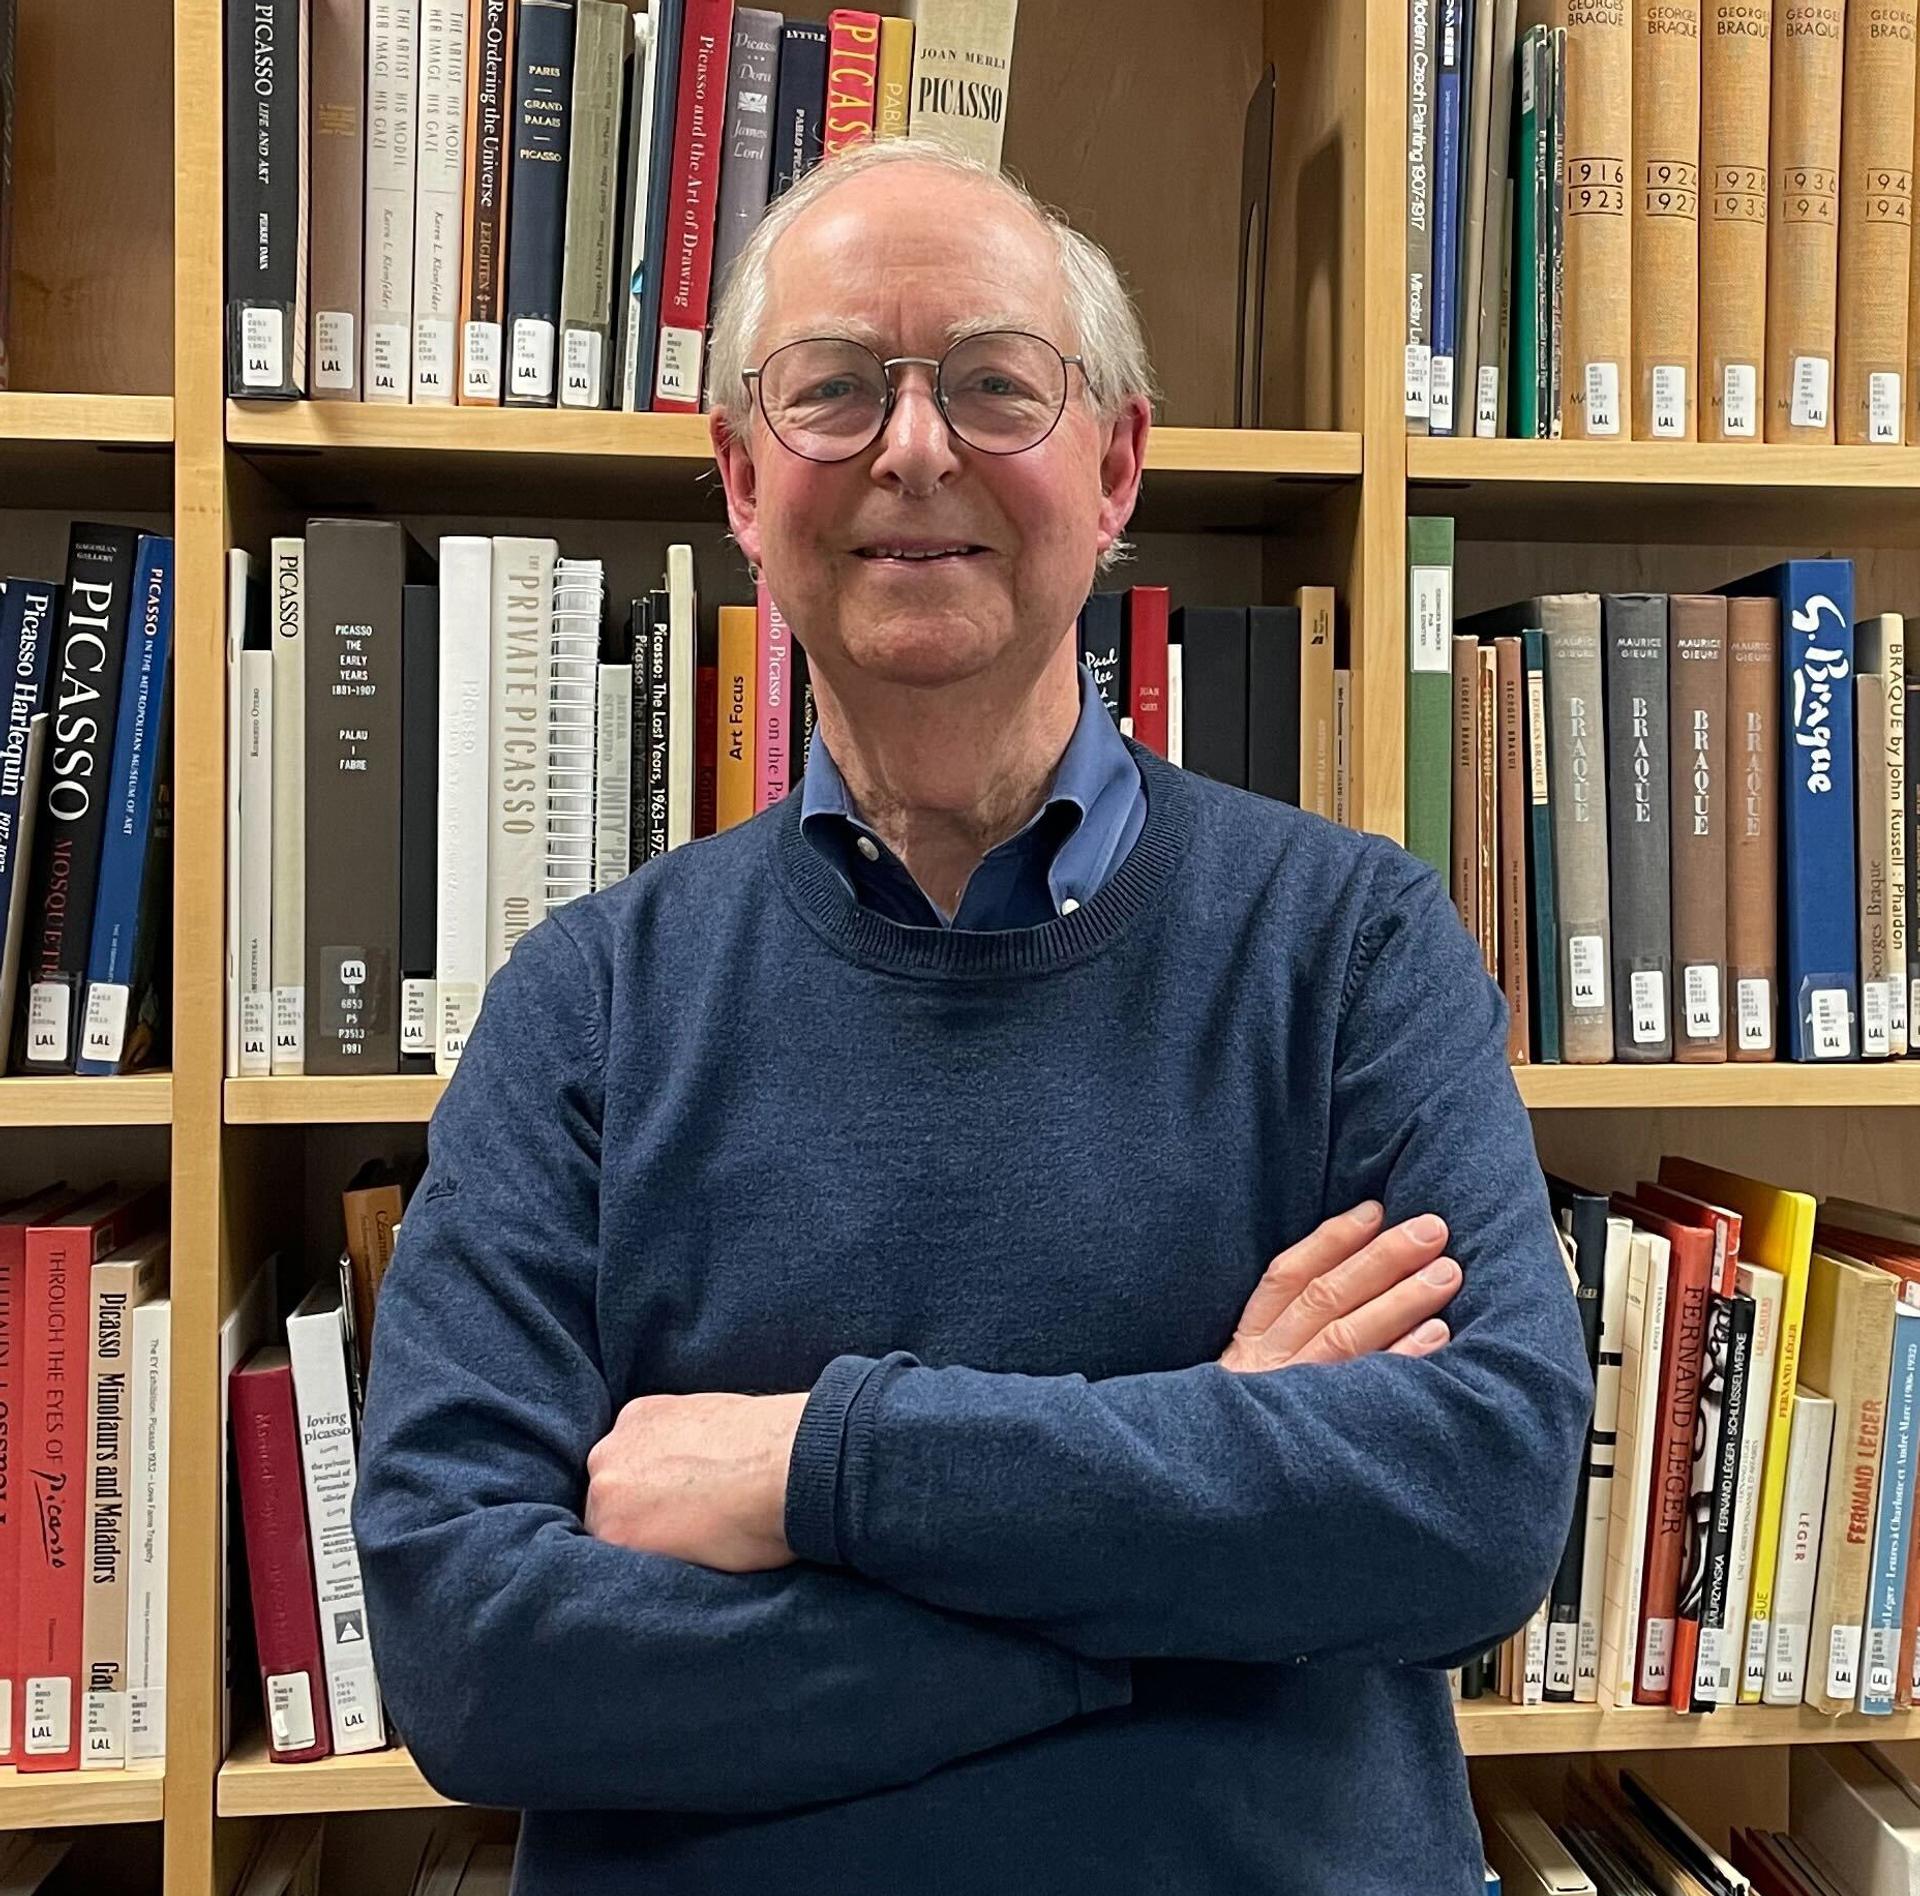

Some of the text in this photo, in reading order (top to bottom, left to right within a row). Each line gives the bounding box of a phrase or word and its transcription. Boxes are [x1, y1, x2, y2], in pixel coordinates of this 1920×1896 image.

[396, 9, 411, 30] THE
[449, 12, 464, 34] THE
[1413, 0, 1429, 51] odern
[1568, 12, 1624, 26] BRAQUE
[480, 0, 504, 104] Re-Ordering
[920, 48, 1006, 70] JOAN MERLI
[528, 65, 561, 78] PARIS
[738, 64, 772, 83] Dora
[1412, 53, 1428, 104] Czech
[254, 3, 274, 185] PICASSO LIFE AND ART
[918, 76, 1003, 124] PICASSO
[524, 100, 563, 112] GRAND
[484, 108, 500, 134] the
[524, 114, 561, 127] PALAIS
[732, 120, 768, 140] James
[794, 108, 805, 146] PABLO
[1409, 104, 1428, 163] Painting
[520, 150, 562, 162] PICASSO
[733, 142, 764, 162] Lord
[480, 137, 499, 208] Universe
[674, 34, 715, 308] Picasso and the Art of Drawing
[1568, 164, 1624, 184] 1916
[1568, 190, 1624, 210] 1923
[1646, 193, 1696, 214] 1927
[250, 359, 269, 371] LAL
[322, 360, 341, 372] LAL
[420, 373, 439, 385] LAL
[469, 372, 488, 384] LAL
[569, 376, 588, 389] LAL
[662, 374, 680, 388] LAL
[1432, 394, 1449, 406] LAL
[1480, 410, 1496, 422] LAL
[1658, 416, 1674, 428] LAL
[1728, 416, 1744, 428] LAL
[1877, 426, 1893, 436] LAL
[279, 554, 299, 638] PICASSO
[335, 624, 373, 636] PICASSO
[346, 640, 362, 651] THE
[1616, 638, 1662, 649] MAURICE
[1677, 638, 1722, 650] MAURICE
[340, 654, 368, 666] EARLY
[1086, 648, 1118, 671] Paul
[1682, 650, 1719, 660] GIEURE
[340, 670, 368, 681] YEARS
[1, 592, 50, 797] Picasso Harlequin
[49, 577, 114, 821] PICASSO
[123, 568, 164, 836] PICASSO IN THE METROPOLITAN MUSEUM OF ART
[502, 574, 540, 834] PRIVATE PICASSO
[650, 622, 668, 784] Picasso: The Last Years,
[729, 676, 744, 761] Art Focus
[768, 646, 786, 774] Picasso on the
[1793, 646, 1850, 794] Braque
[339, 729, 368, 740] PALAU
[1506, 680, 1516, 770] GEORGES BRAQUE
[1461, 727, 1470, 768] BRAQUE
[339, 759, 367, 770] FABRE
[1570, 697, 1590, 822] BRAQUE
[1632, 696, 1650, 822] BRAQUE
[1693, 710, 1710, 836] BRAQUE
[1746, 712, 1762, 837] BRAQUE
[600, 776, 628, 835] UNITY
[1886, 643, 1906, 950] BRAQUE by John Russell Phaidon
[1866, 859, 1886, 917] Braque
[344, 967, 362, 978] LAL
[1638, 1020, 1656, 1032] LAL
[1693, 1012, 1710, 1024] LAL
[35, 1034, 55, 1046] LAL
[404, 1026, 423, 1038] LAL
[1822, 1036, 1840, 1048] LAL
[1868, 1028, 1885, 1039] LAL
[245, 1041, 264, 1053] LAL
[150, 1338, 160, 1355] The
[1672, 1286, 1704, 1428] FERNAND
[1778, 1362, 1793, 1419] FERNAND
[28, 1249, 67, 1569] THROUGH THE EYES OF Picasso
[306, 1412, 347, 1428] loving
[92, 1292, 128, 1584] Picasso Minotaurs and Matadors
[148, 1416, 158, 1452] Picasso
[304, 1426, 351, 1445] picasso
[1718, 1441, 1738, 1534] FERNAND LÉGER
[1846, 1465, 1874, 1545] FERNAND
[144, 1529, 155, 1564] Tragedy
[1525, 1673, 1541, 1684] LAL
[1554, 1672, 1570, 1684] LAL
[1648, 1665, 1665, 1676] LAL
[1777, 1672, 1793, 1683] LAL
[1698, 1676, 1715, 1688] LAL
[31, 1726, 52, 1738] LAL
[91, 1738, 111, 1750] LAL
